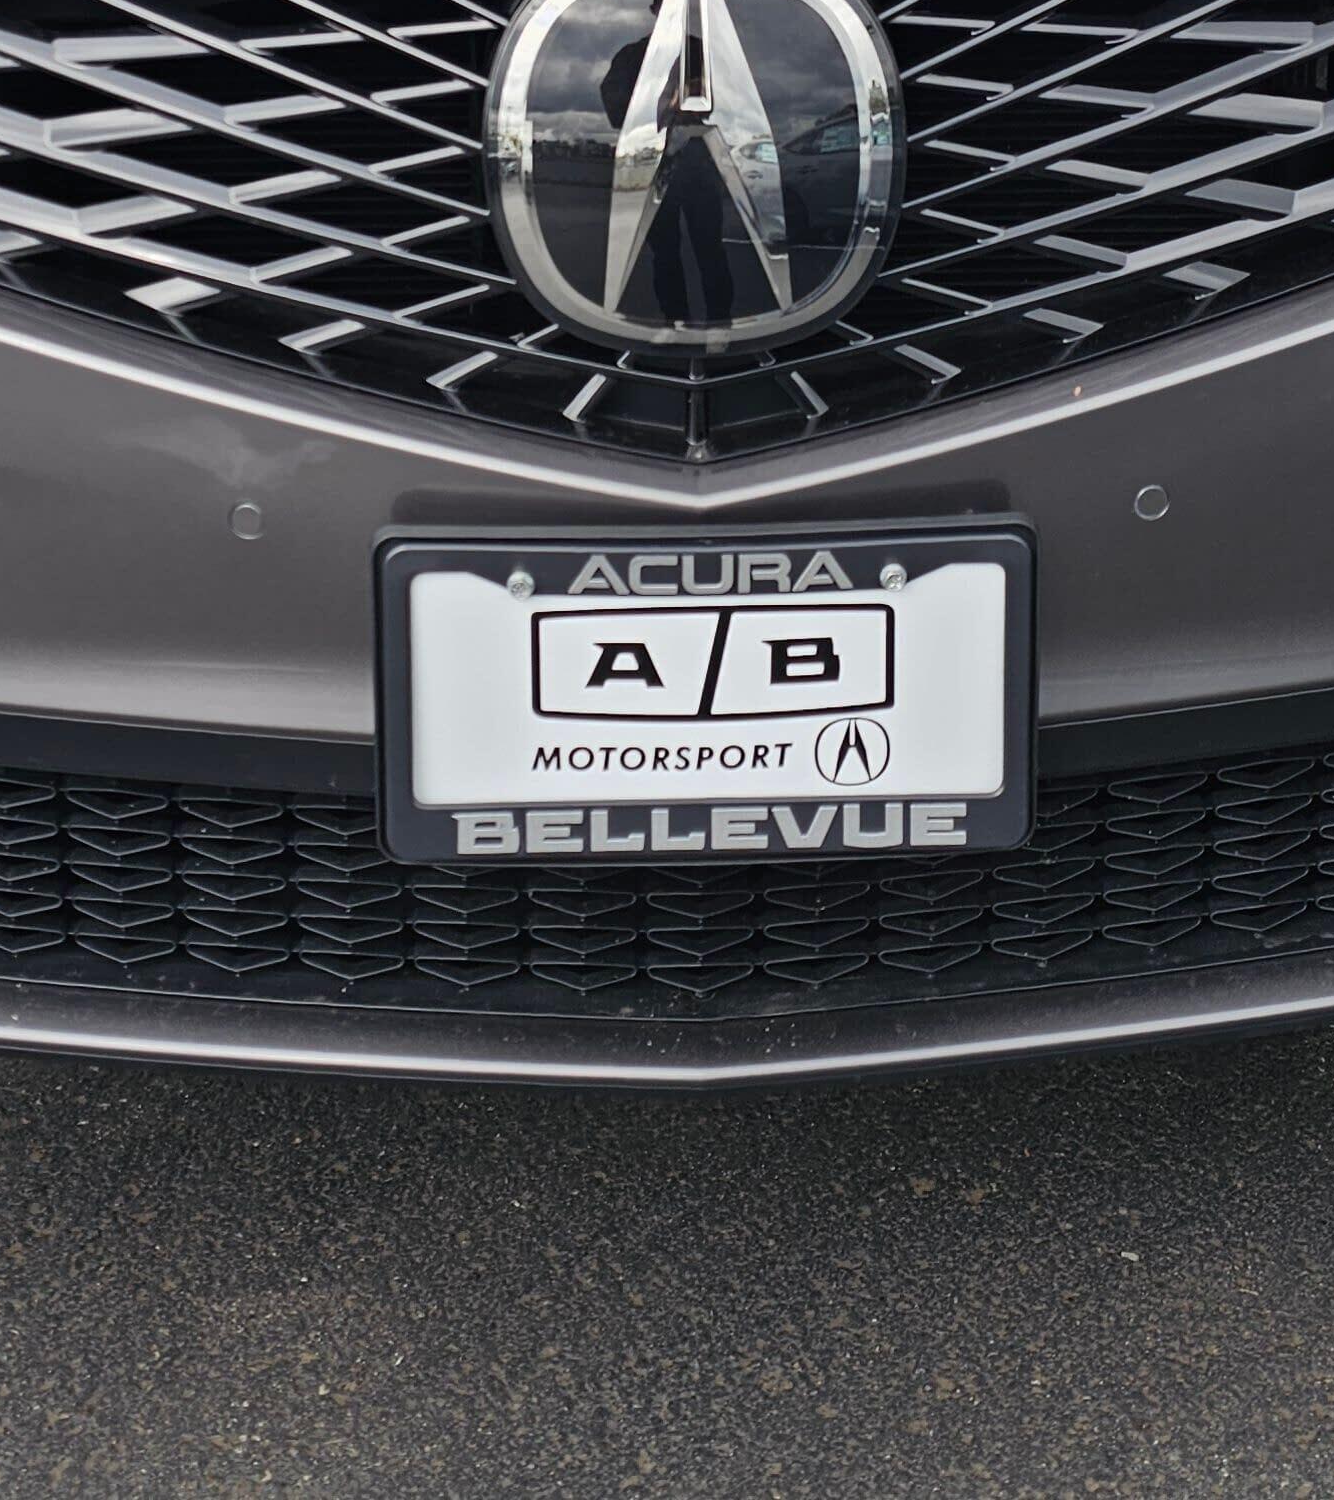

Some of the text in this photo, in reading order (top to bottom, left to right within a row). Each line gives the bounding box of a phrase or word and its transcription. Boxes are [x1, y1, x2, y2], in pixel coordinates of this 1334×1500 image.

[568, 551, 854, 596] ACURA
[533, 742, 793, 772] MOTORSPORT
[451, 803, 967, 855] BELLEVUE
